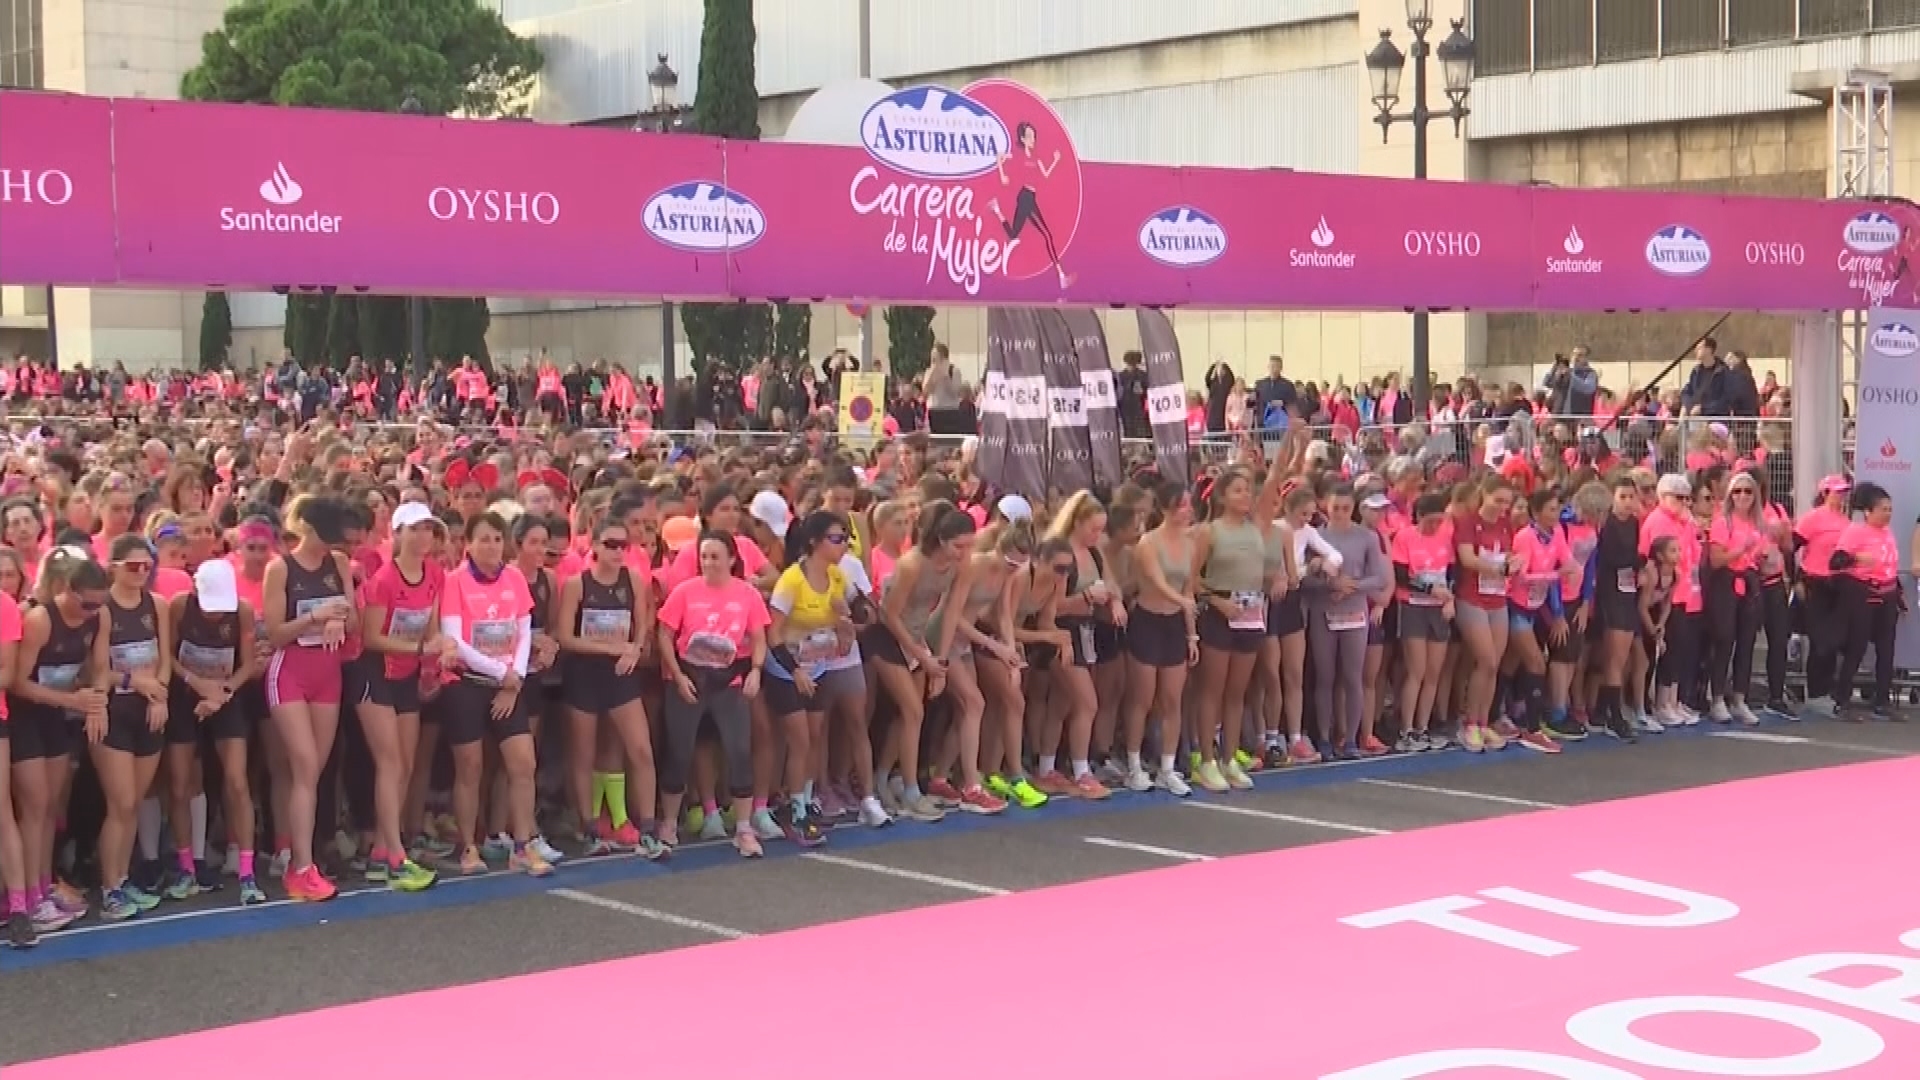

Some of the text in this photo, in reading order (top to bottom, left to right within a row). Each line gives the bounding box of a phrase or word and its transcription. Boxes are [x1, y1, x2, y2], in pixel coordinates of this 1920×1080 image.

[873, 114, 998, 156] ASTURIANA
[428, 186, 560, 225] OYSHO
[849, 165, 975, 221] Carrera
[220, 207, 342, 233] Santander
[652, 203, 756, 235] ASTURIANA
[1146, 227, 1221, 251] ASTURIANA
[1403, 230, 1481, 257] OYSHO
[883, 216, 1021, 295] de la Mujer
[1289, 248, 1356, 268] Santander
[1546, 255, 1603, 273] Santander
[1651, 243, 1708, 263] ASTURIANA
[1745, 241, 1805, 266] OYSHO
[1837, 248, 1883, 272] Carrera
[1863, 270, 1900, 306] Mujer
[1862, 385, 1919, 406] OYSHO
[1863, 457, 1913, 471] Santander
[1337, 869, 1740, 957] TU
